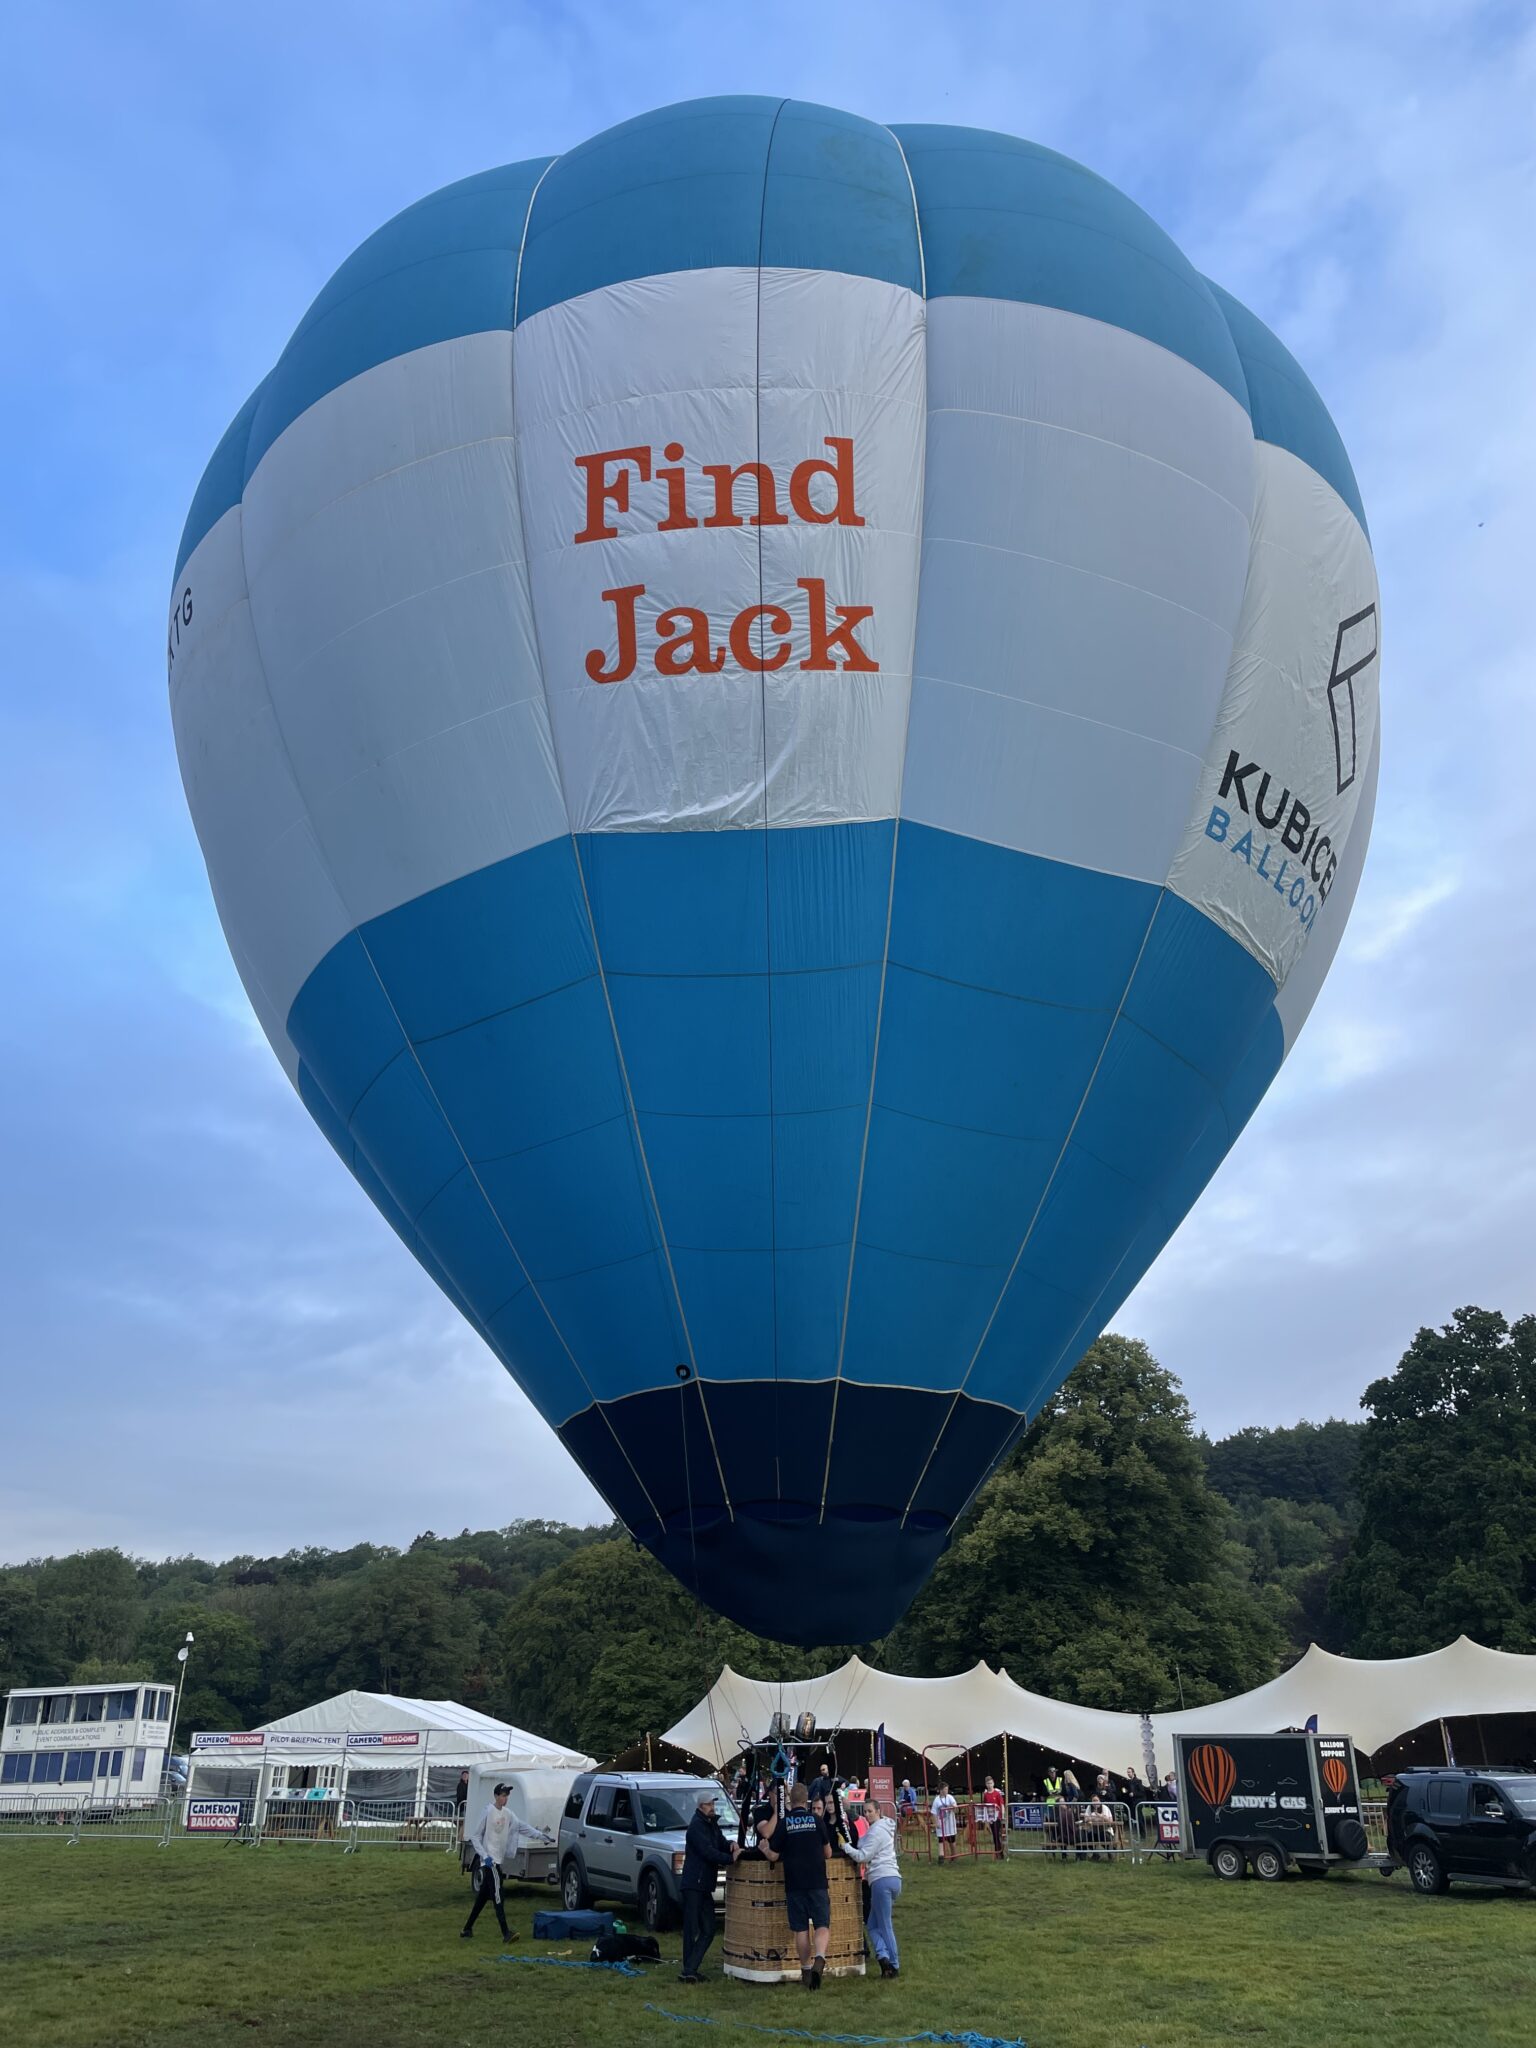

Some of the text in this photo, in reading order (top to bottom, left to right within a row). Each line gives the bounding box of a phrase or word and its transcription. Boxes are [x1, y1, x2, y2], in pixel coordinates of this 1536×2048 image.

[575, 437, 865, 544] Find
[585, 578, 879, 684] Jack
[1217, 749, 1337, 906] KUBICE
[197, 1735, 263, 1744] CAMERON BALLOONS
[349, 1735, 418, 1744] CAMERON BALLOONS
[1231, 1795, 1307, 1809] ANDY'S GAS
[192, 1804, 238, 1814] CAMERON
[190, 1816, 236, 1827] BALLOONS
[785, 1815, 815, 1825] Nova
